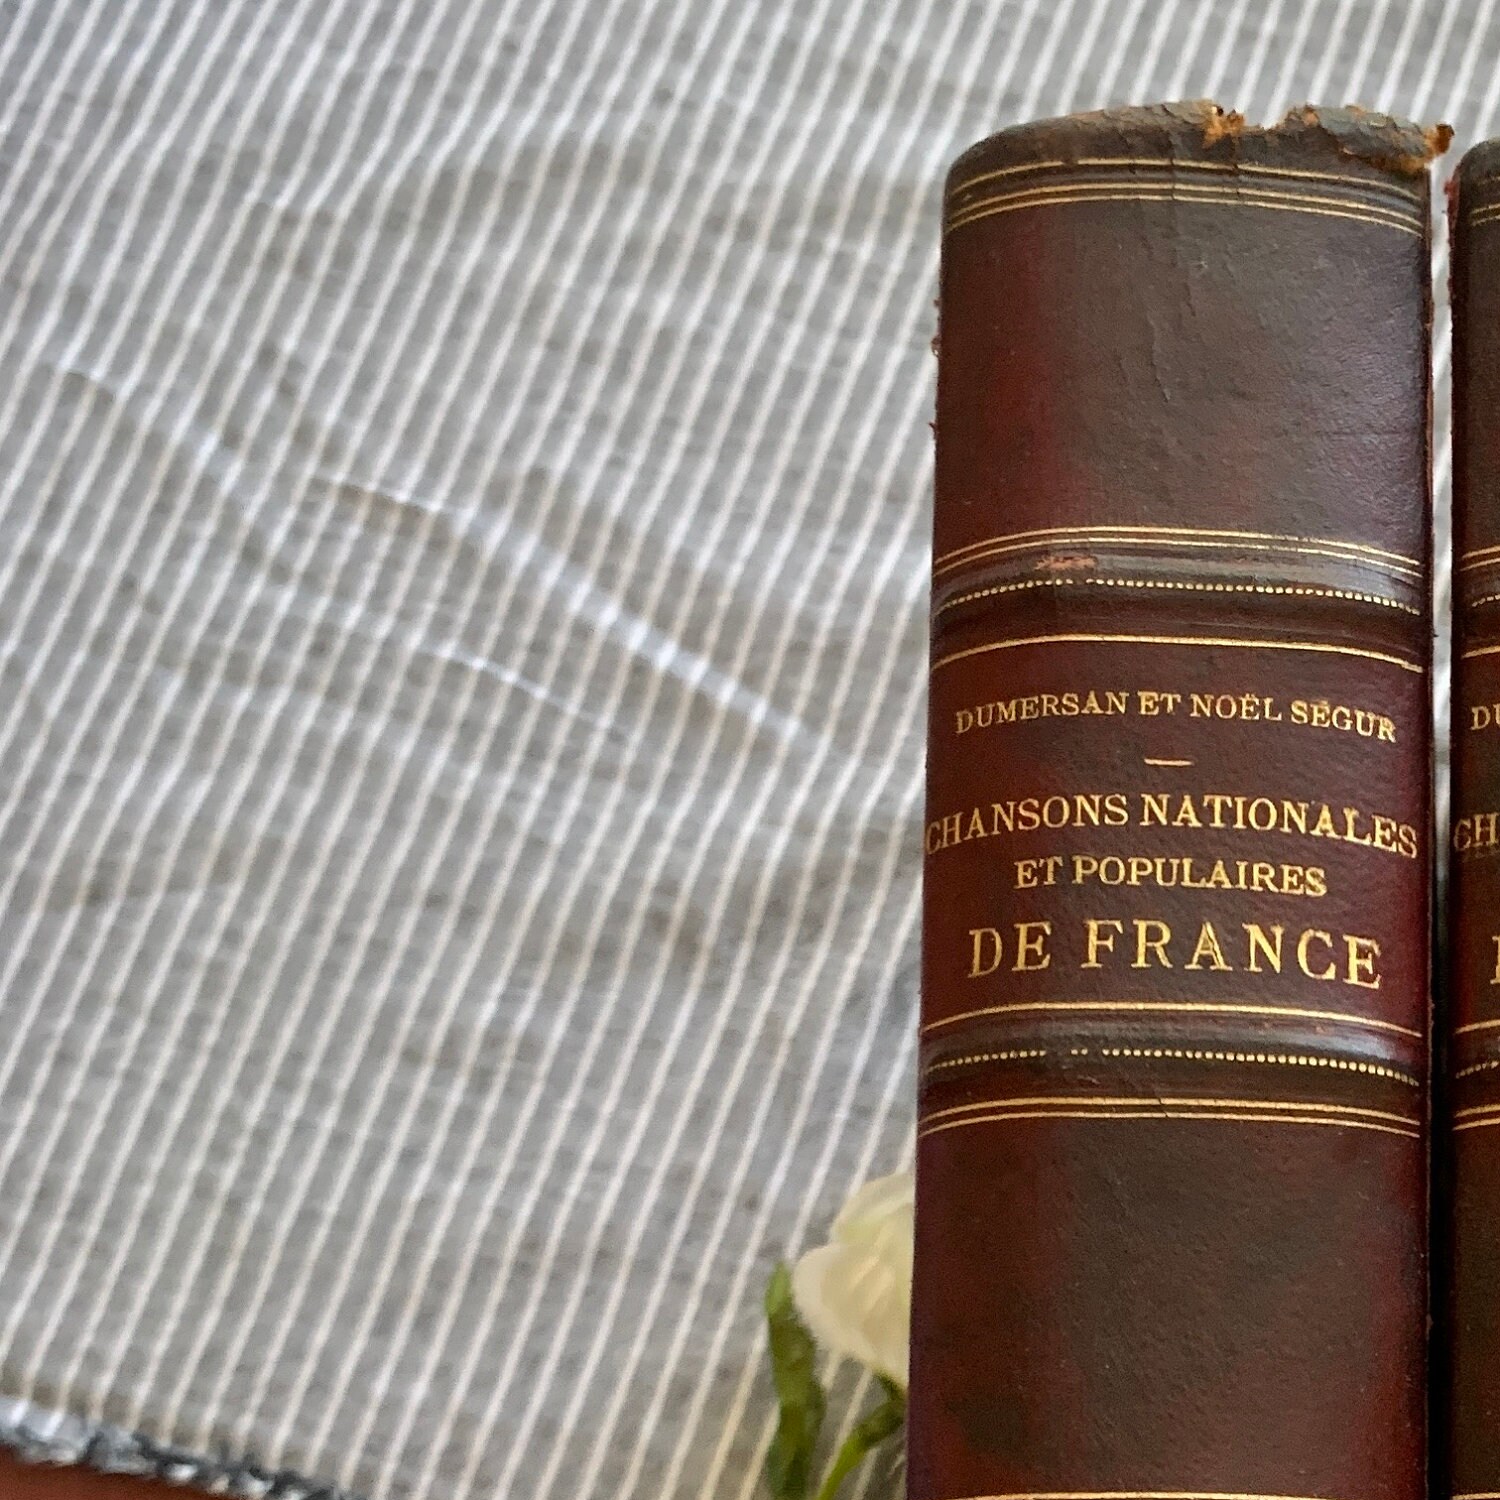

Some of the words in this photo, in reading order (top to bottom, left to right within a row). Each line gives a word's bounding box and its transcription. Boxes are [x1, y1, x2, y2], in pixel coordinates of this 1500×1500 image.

[956, 691, 1130, 734] DUMERSAN
[1137, 690, 1181, 716] ET
[1190, 694, 1283, 721] NOËL
[925, 794, 1129, 855] CHANSONS
[1140, 794, 1418, 859] NATIONALES
[1014, 858, 1063, 890] ET
[1071, 855, 1328, 897] POPULAIRES
[967, 921, 1052, 979] DE
[1081, 919, 1382, 990] FRANCE
